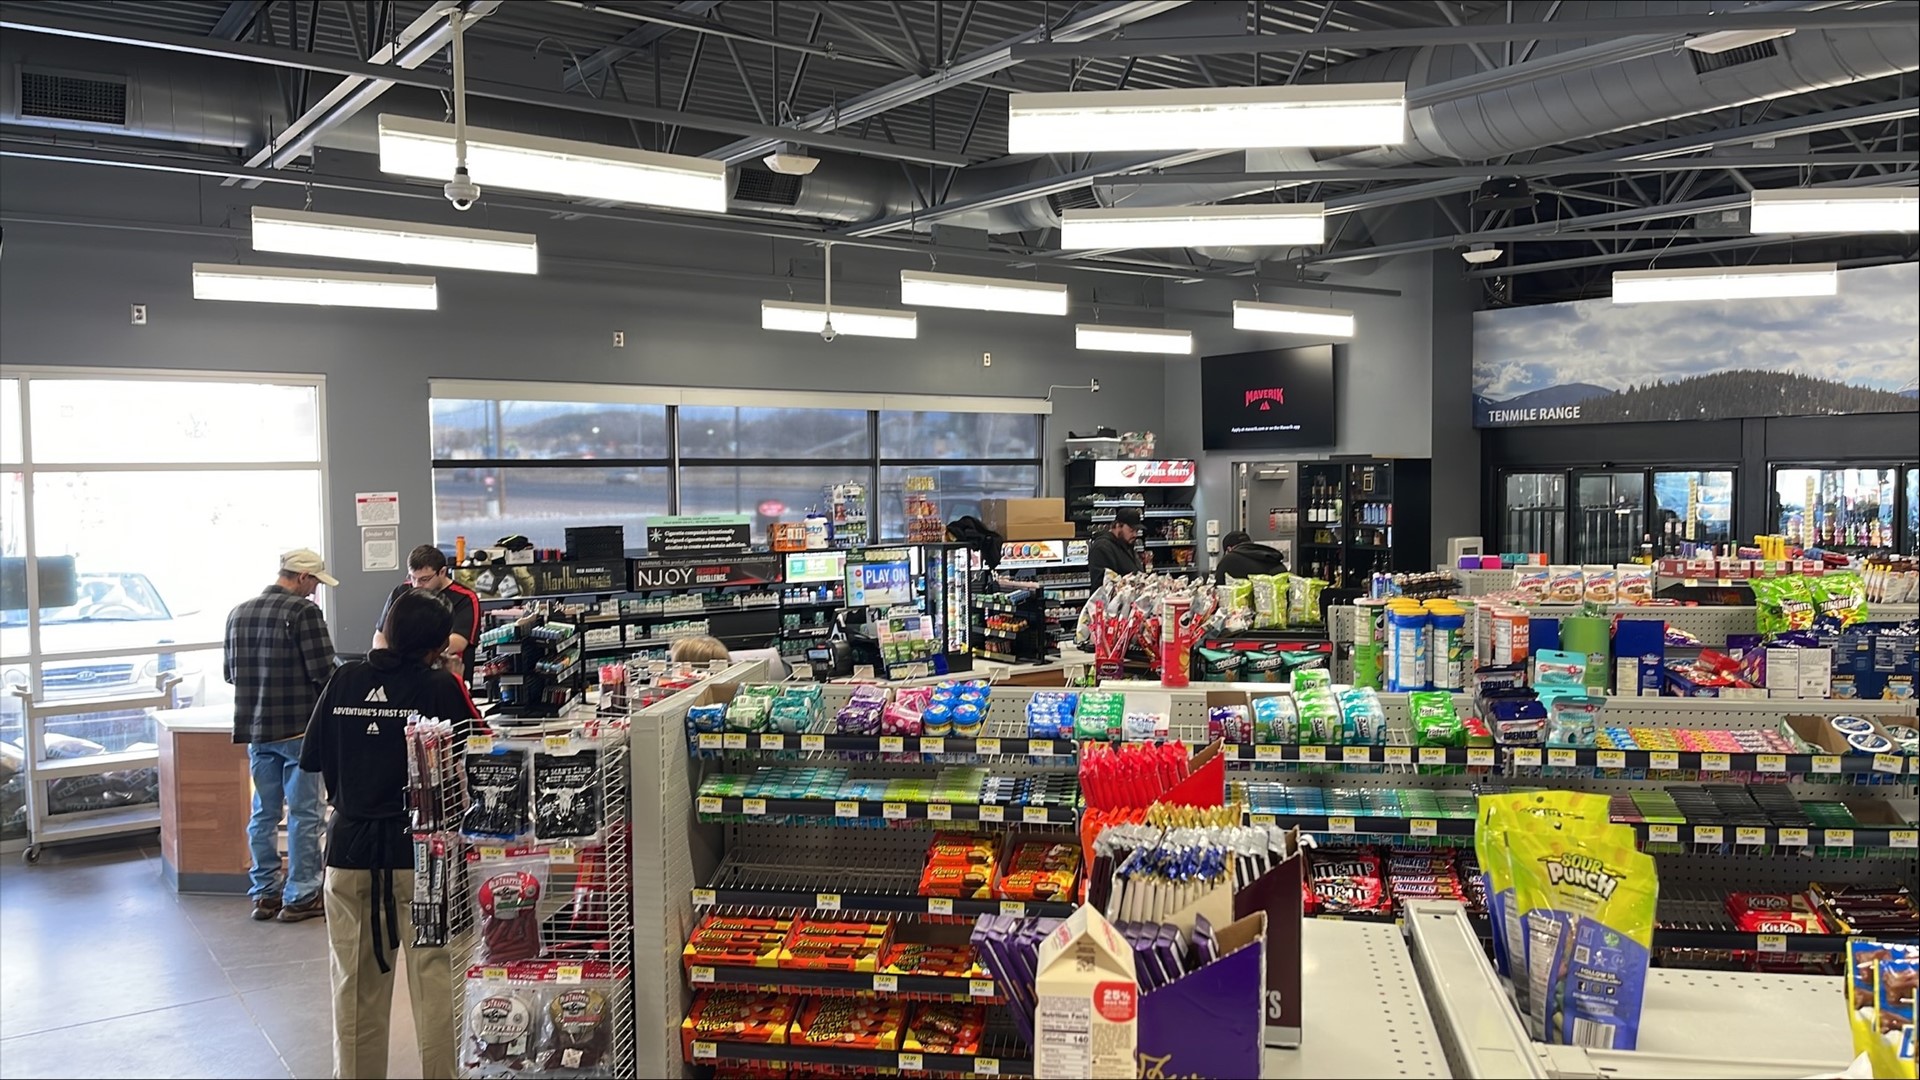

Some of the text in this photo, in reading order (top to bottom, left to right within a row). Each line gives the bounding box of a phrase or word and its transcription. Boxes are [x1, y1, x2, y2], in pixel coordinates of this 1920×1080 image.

[1245, 388, 1284, 407] MAVERIK
[1488, 406, 1580, 422] TENMILE RANGE
[542, 566, 590, 591] Marlboro
[638, 567, 693, 587] NJOY
[865, 568, 907, 584] PLAY ON
[333, 707, 419, 717] ADVENTURE'S FIRST STOP
[1503, 731, 1538, 740] GRENADES
[1561, 853, 1603, 873] SOUR
[1547, 862, 1618, 901] PUNCH
[1759, 922, 1803, 933] KitKat
[1104, 989, 1131, 1000] 25%
[696, 1022, 735, 1032] STICKS
[805, 1030, 843, 1042] STICKS
[1074, 1035, 1089, 1043] 140
